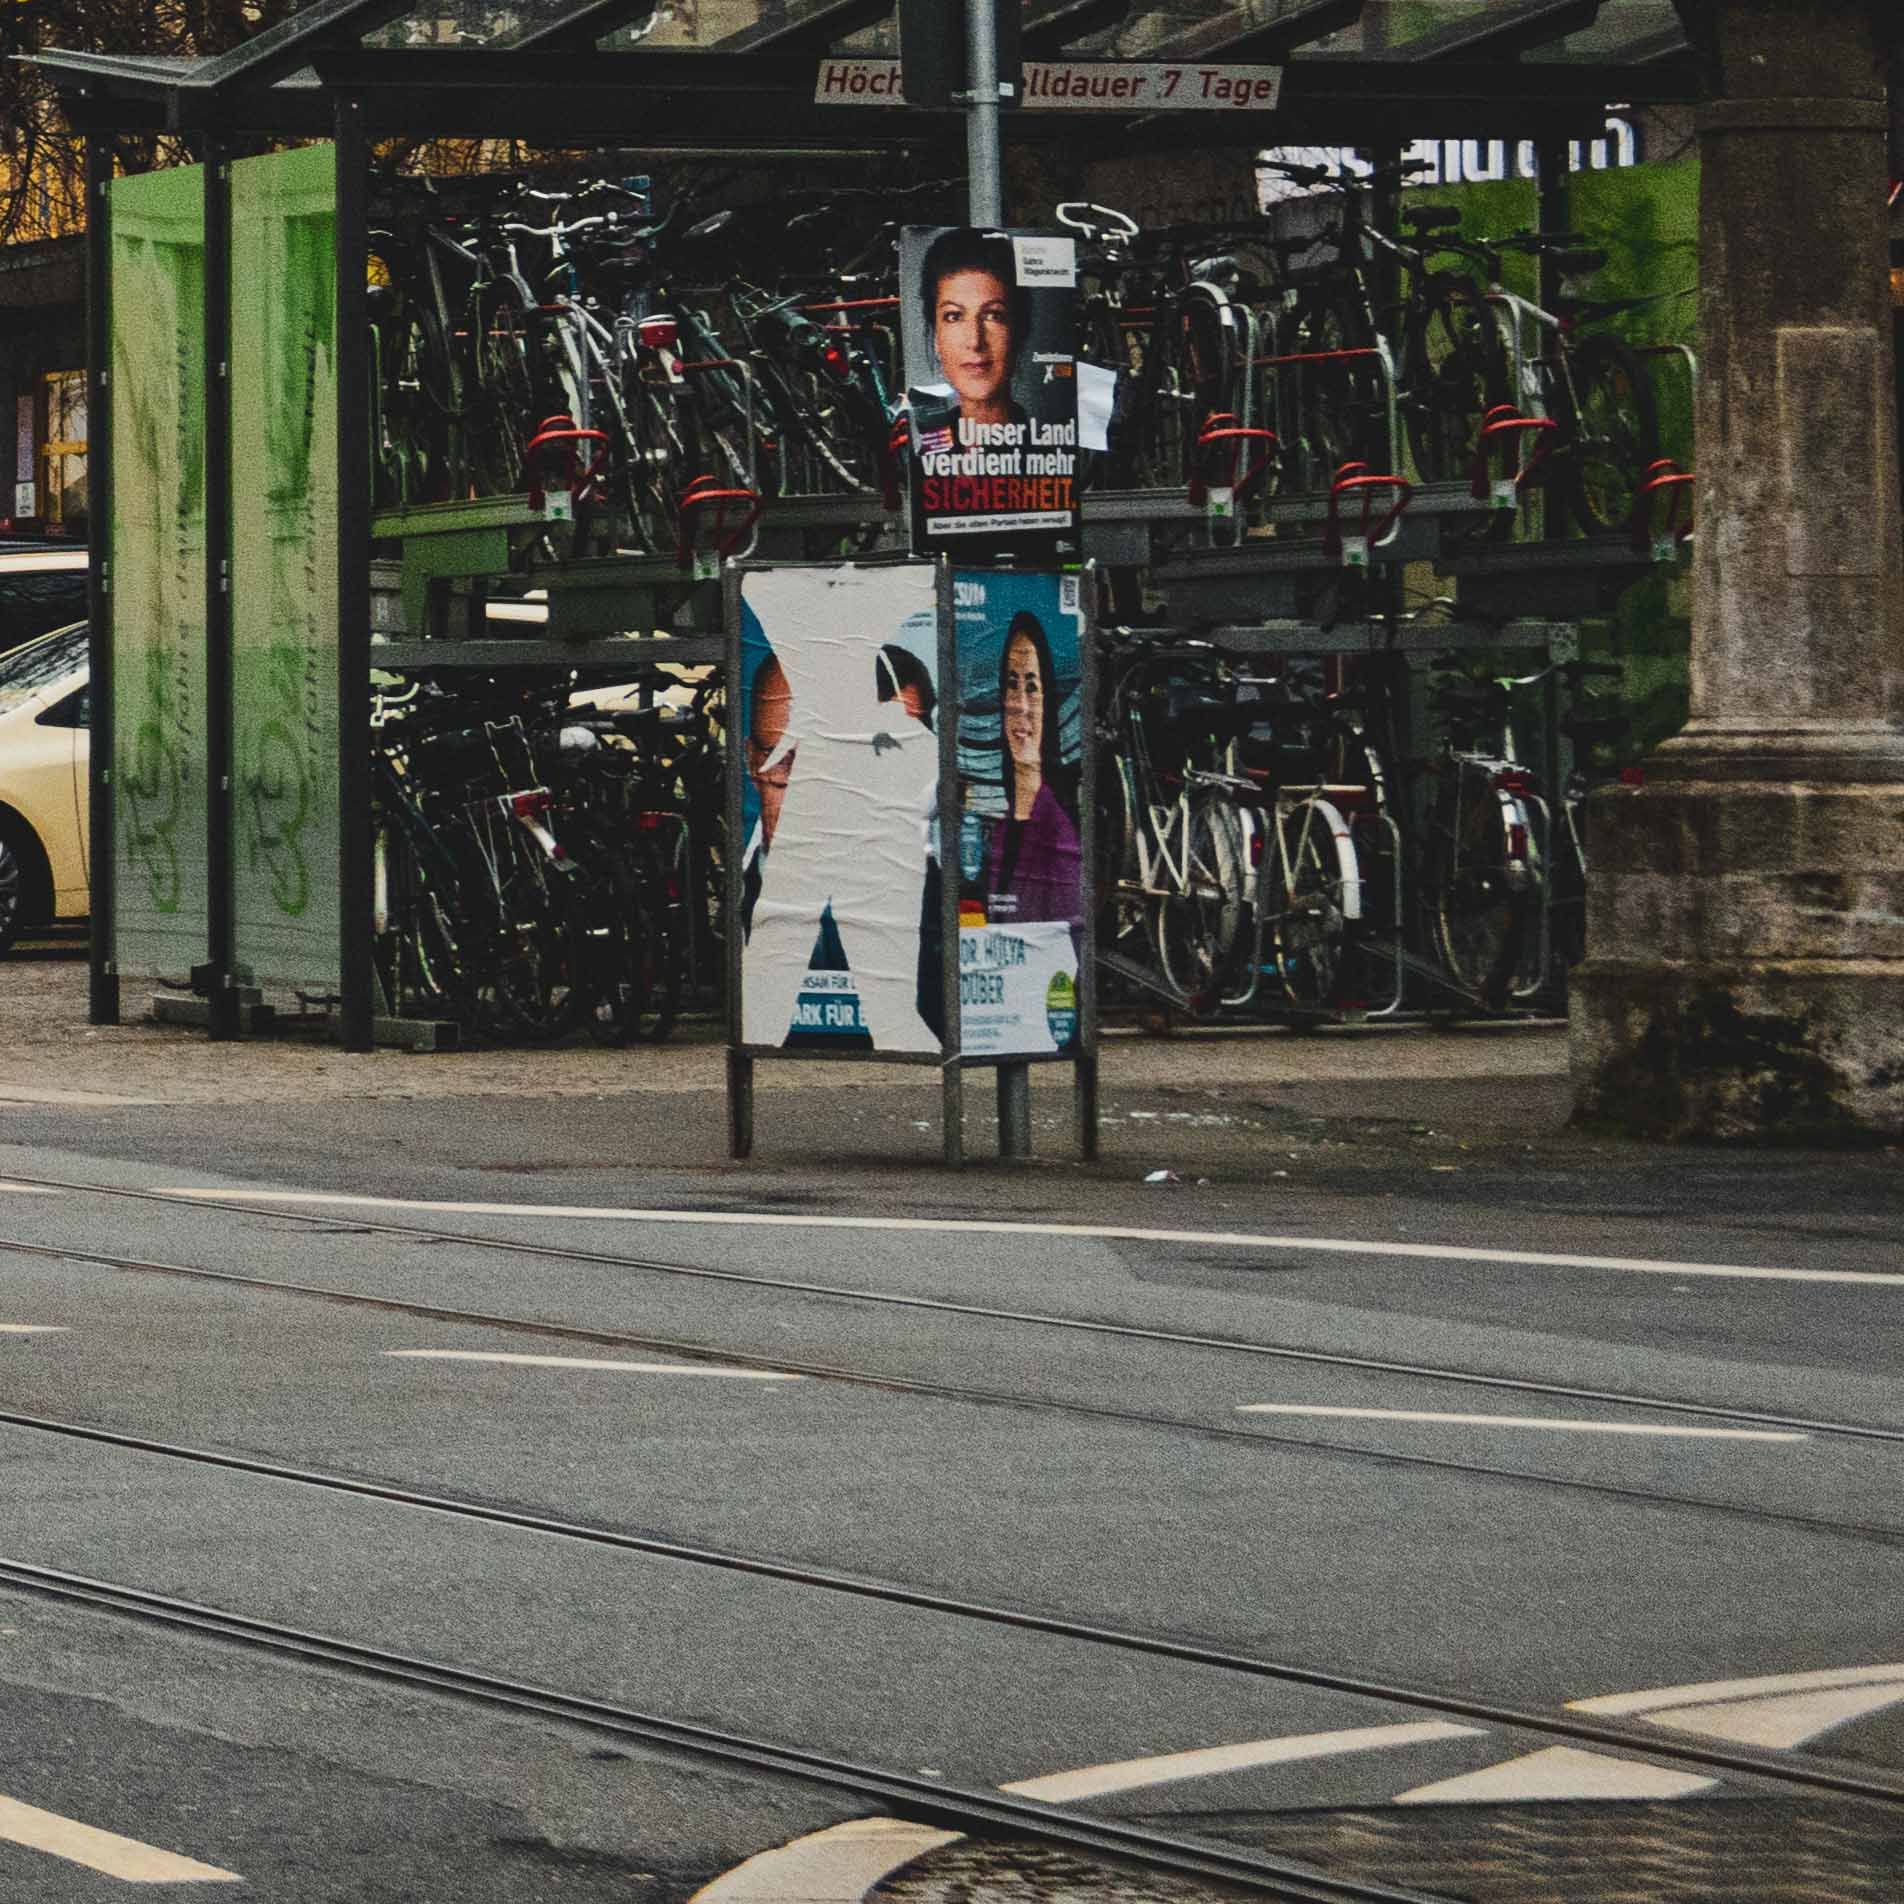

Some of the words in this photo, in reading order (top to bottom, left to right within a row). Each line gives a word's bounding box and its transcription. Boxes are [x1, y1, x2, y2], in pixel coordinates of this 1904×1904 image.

[1200, 71, 1271, 106] Tage
[958, 417, 1026, 446] Unser
[1030, 417, 1075, 446] Land
[922, 448, 1022, 476] verdient
[1026, 448, 1075, 475] mehr
[923, 479, 1077, 510] SICHERHEIT.
[825, 1000, 854, 1026] FÜR
